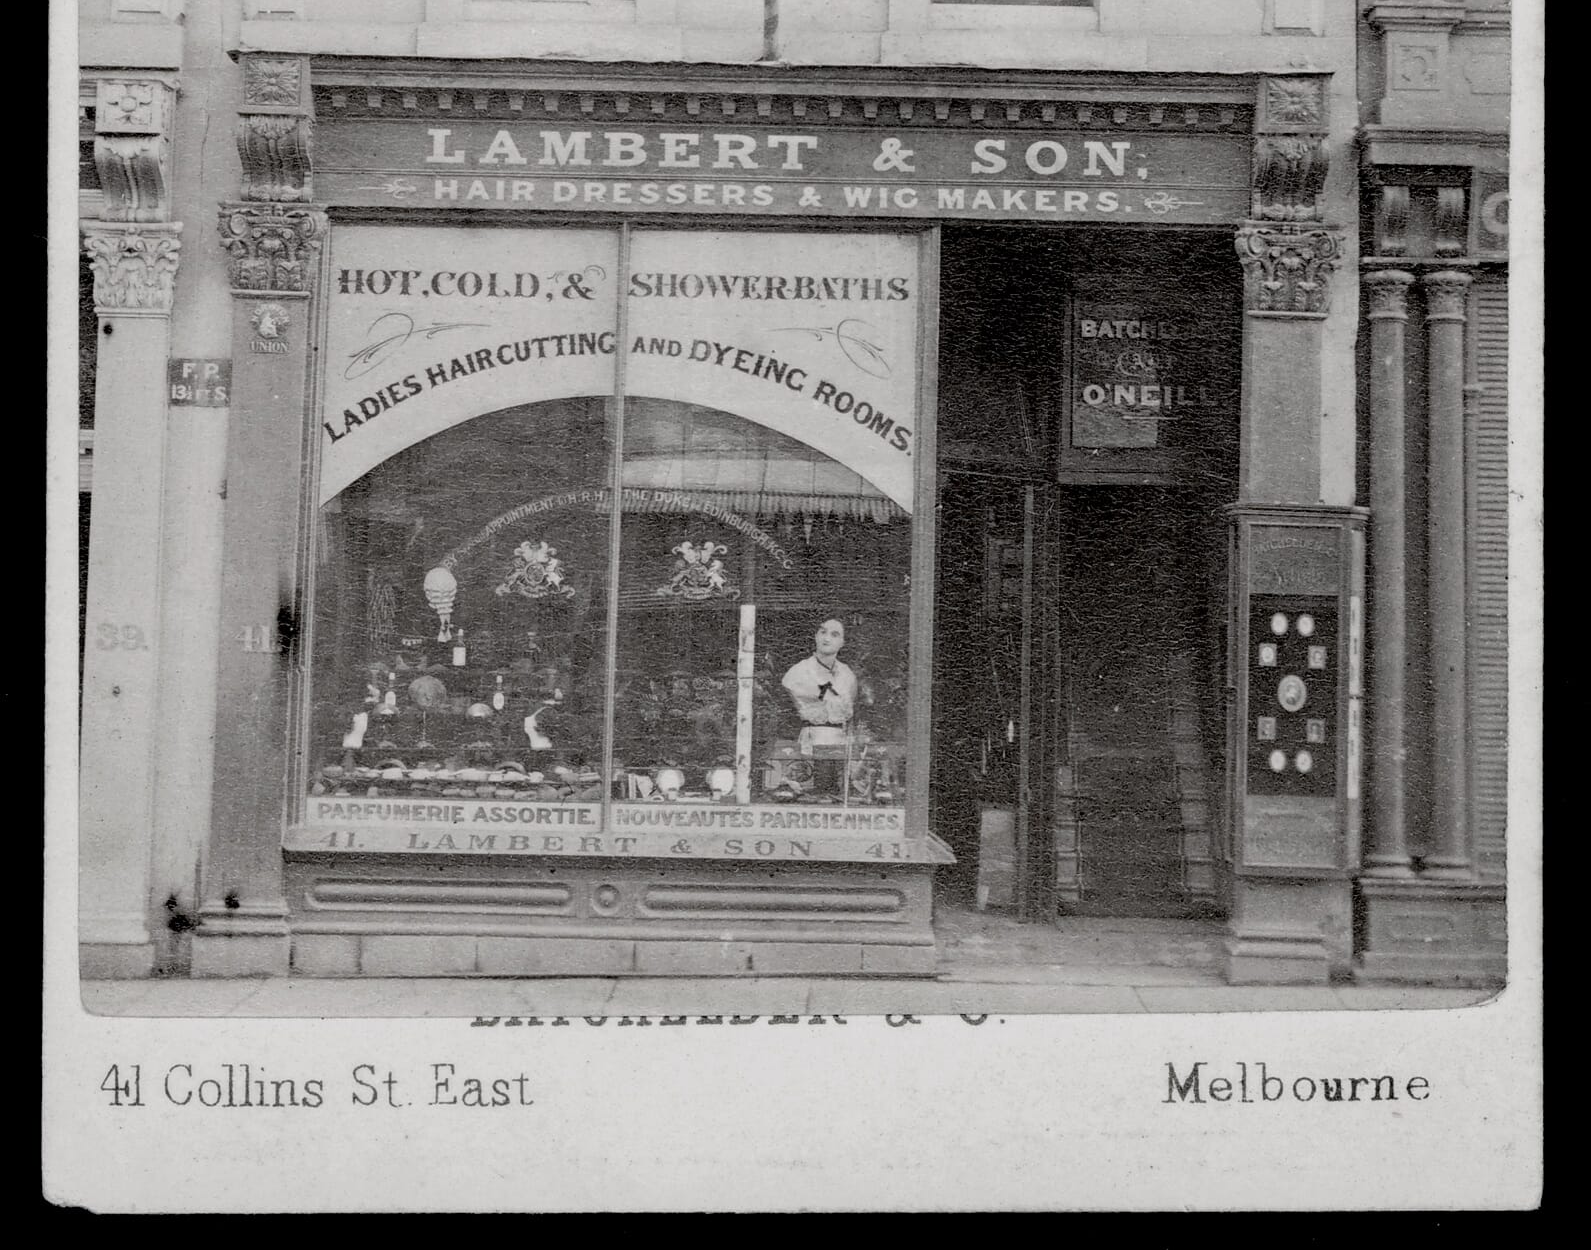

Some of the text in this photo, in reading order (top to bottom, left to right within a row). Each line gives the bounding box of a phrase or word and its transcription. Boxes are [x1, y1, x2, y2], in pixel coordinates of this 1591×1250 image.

[425, 128, 818, 171] LAMBERT
[872, 136, 916, 172] &
[434, 179, 1133, 213] HAIR DRESSERS & WIG MAKERS.
[561, 266, 603, 300] &
[249, 340, 289, 353] UNION
[322, 374, 423, 444] LADIES
[631, 336, 682, 357] AND
[687, 339, 808, 392] DYEING
[812, 379, 913, 457] ROOMS.
[623, 489, 648, 501] THE
[317, 802, 465, 823] PARFUMERIE
[472, 805, 596, 826] ASSORTIE.
[407, 833, 637, 854] LAMBERT
[670, 838, 692, 855] &
[724, 840, 812, 857] SON
